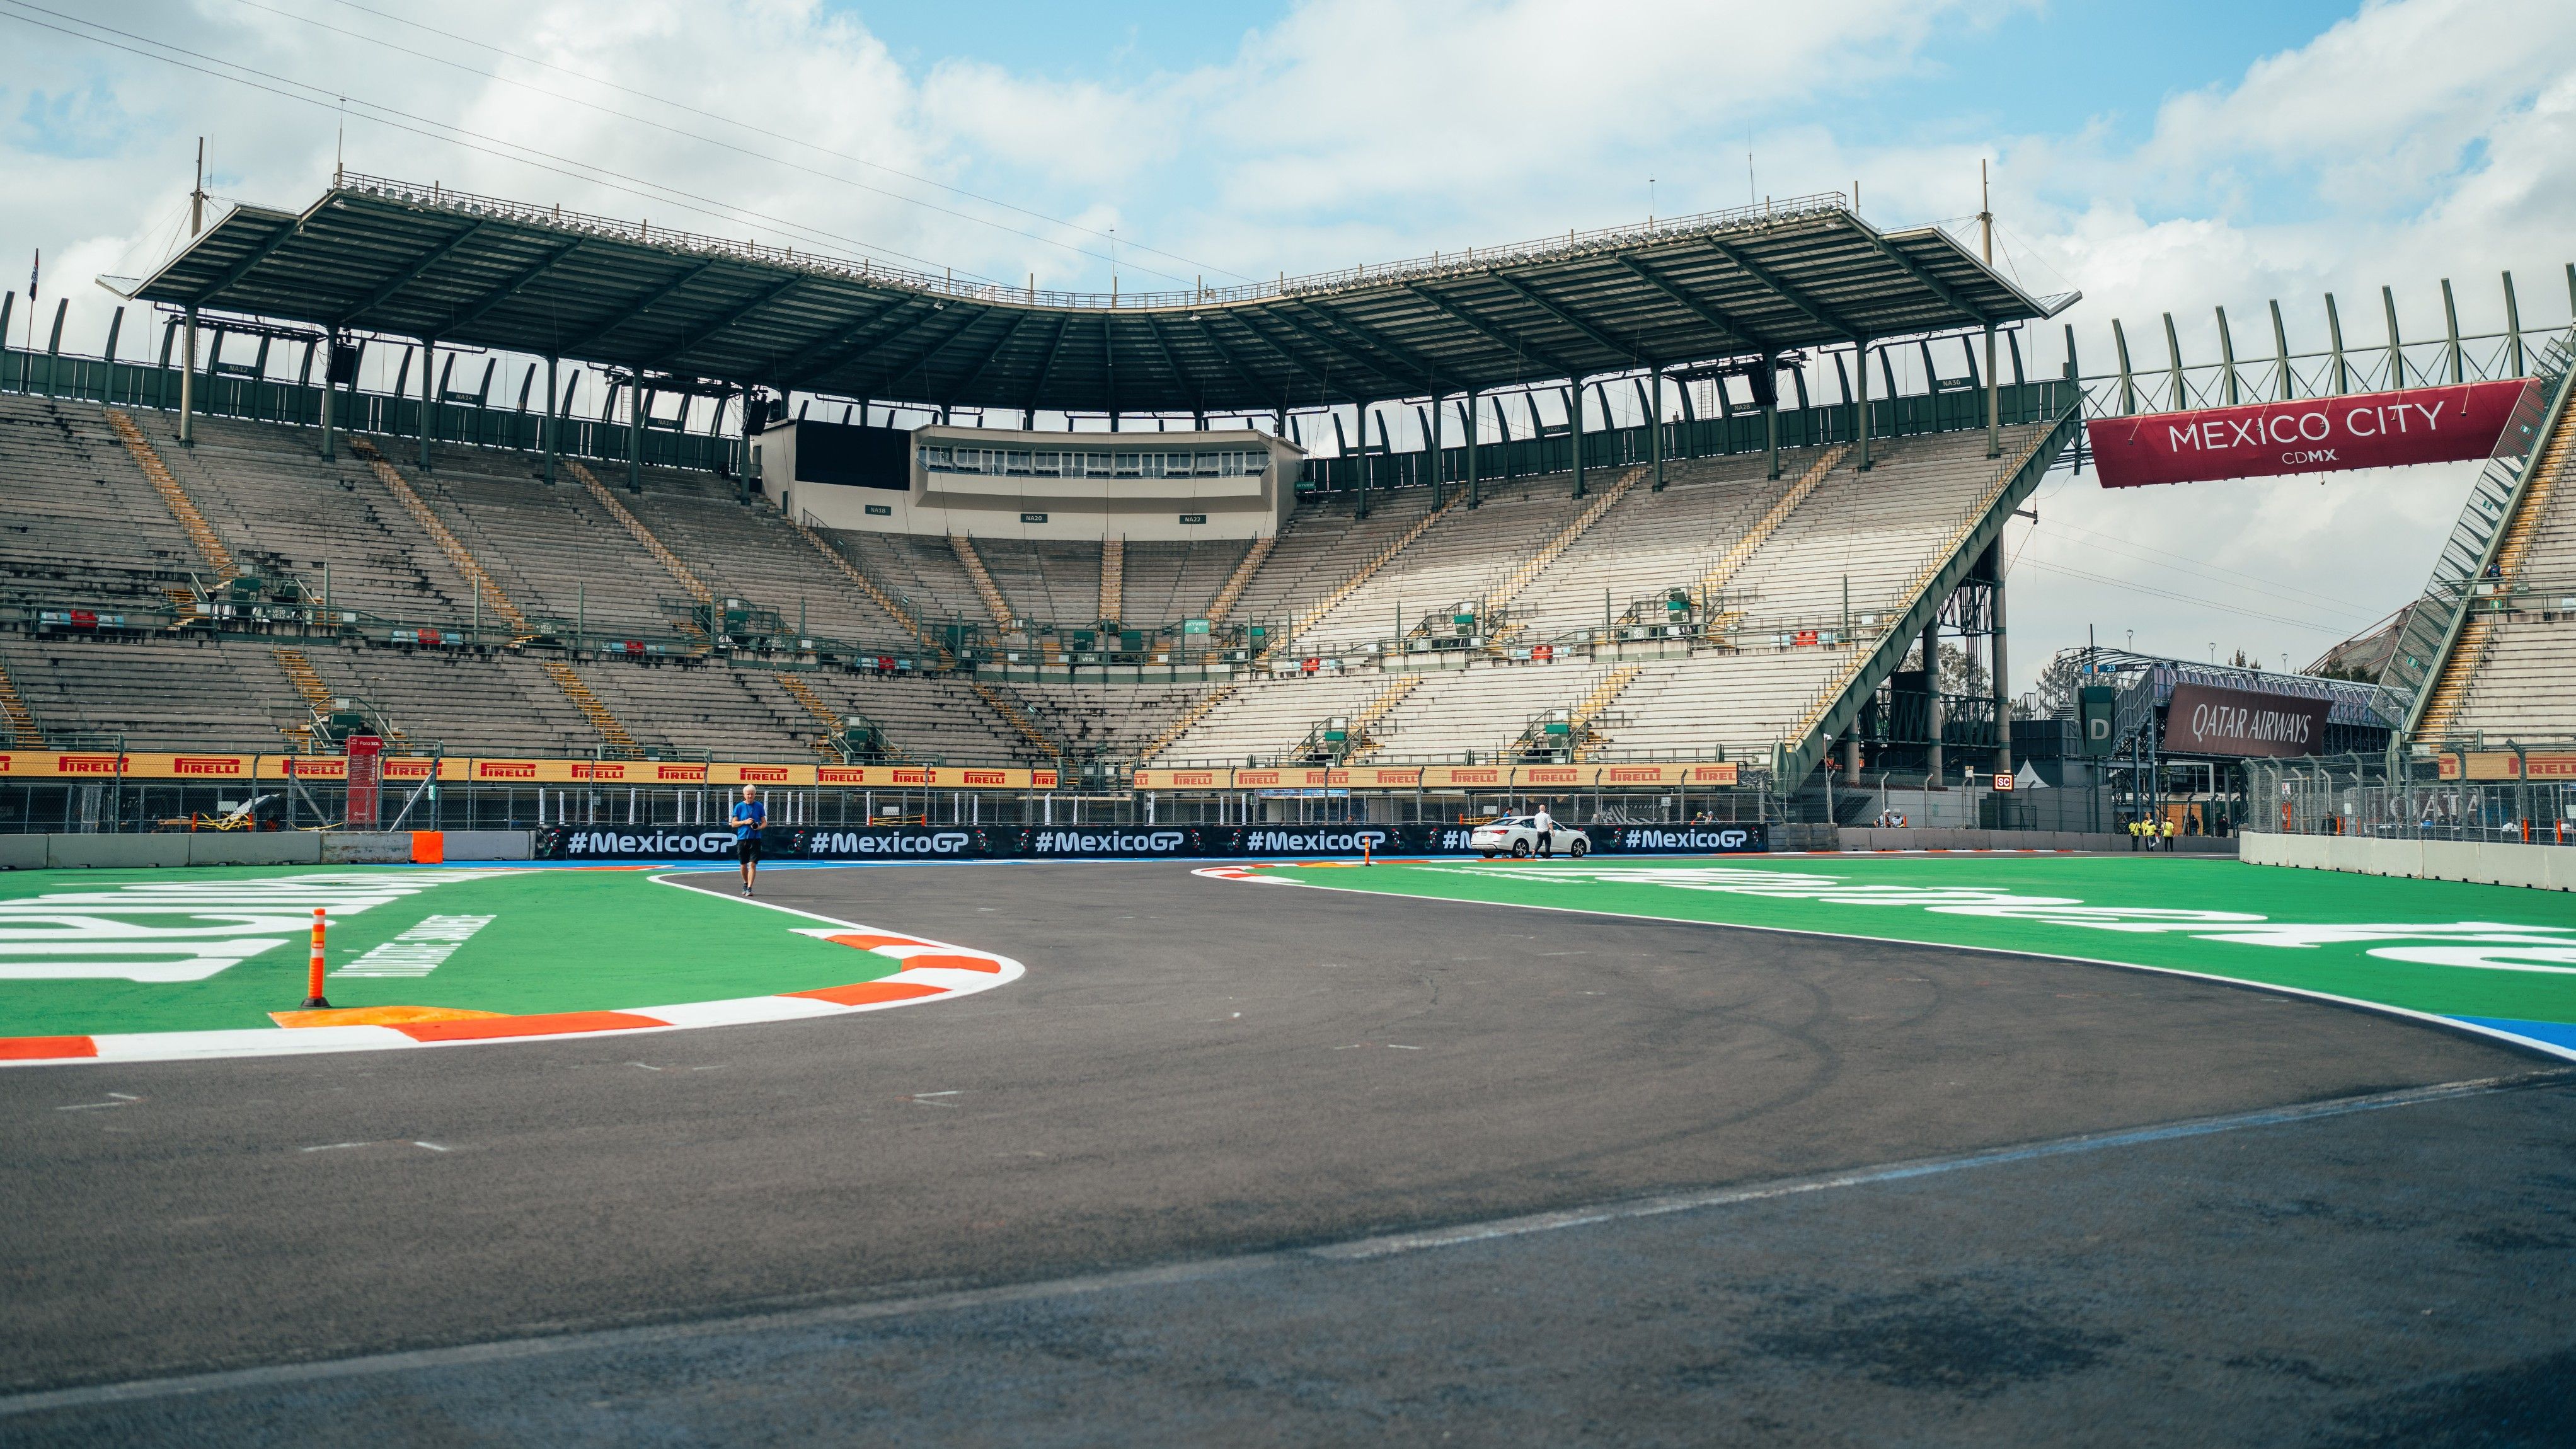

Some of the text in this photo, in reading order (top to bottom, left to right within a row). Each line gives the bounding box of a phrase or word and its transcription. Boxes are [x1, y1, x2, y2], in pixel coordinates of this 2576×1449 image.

[2169, 401, 2445, 453] MEXICO CITY
[2282, 448, 2337, 465] CDMX
[2090, 719, 2110, 740] D
[2192, 703, 2311, 744] QATAR AIRWAYS
[174, 758, 241, 774] PIRELLI
[480, 762, 537, 777] PIRELLI
[571, 764, 625, 779] PIRELLI
[2508, 757, 2576, 775] PREL
[739, 766, 788, 782] PIRELLI
[818, 768, 865, 783] PIRELLI
[892, 770, 937, 783] PIRELLI
[963, 771, 1006, 785] PIRELLI
[1173, 773, 1212, 785] PIRELLI
[1238, 772, 1279, 785] PIRELLI
[1306, 771, 1349, 784] PIRELLI
[1451, 770, 1498, 783] PIRELLI
[1529, 768, 1578, 782] PIRELLI
[1610, 768, 1661, 782] PIRELLI
[1998, 777, 2010, 787] SC
[568, 830, 739, 853] #MexicoGP
[810, 831, 969, 853] #MexicoGP
[1035, 830, 1184, 852] #MexicoGP
[1247, 830, 1386, 851] #MexicoGP
[1626, 828, 1747, 848] #MexicoGP
